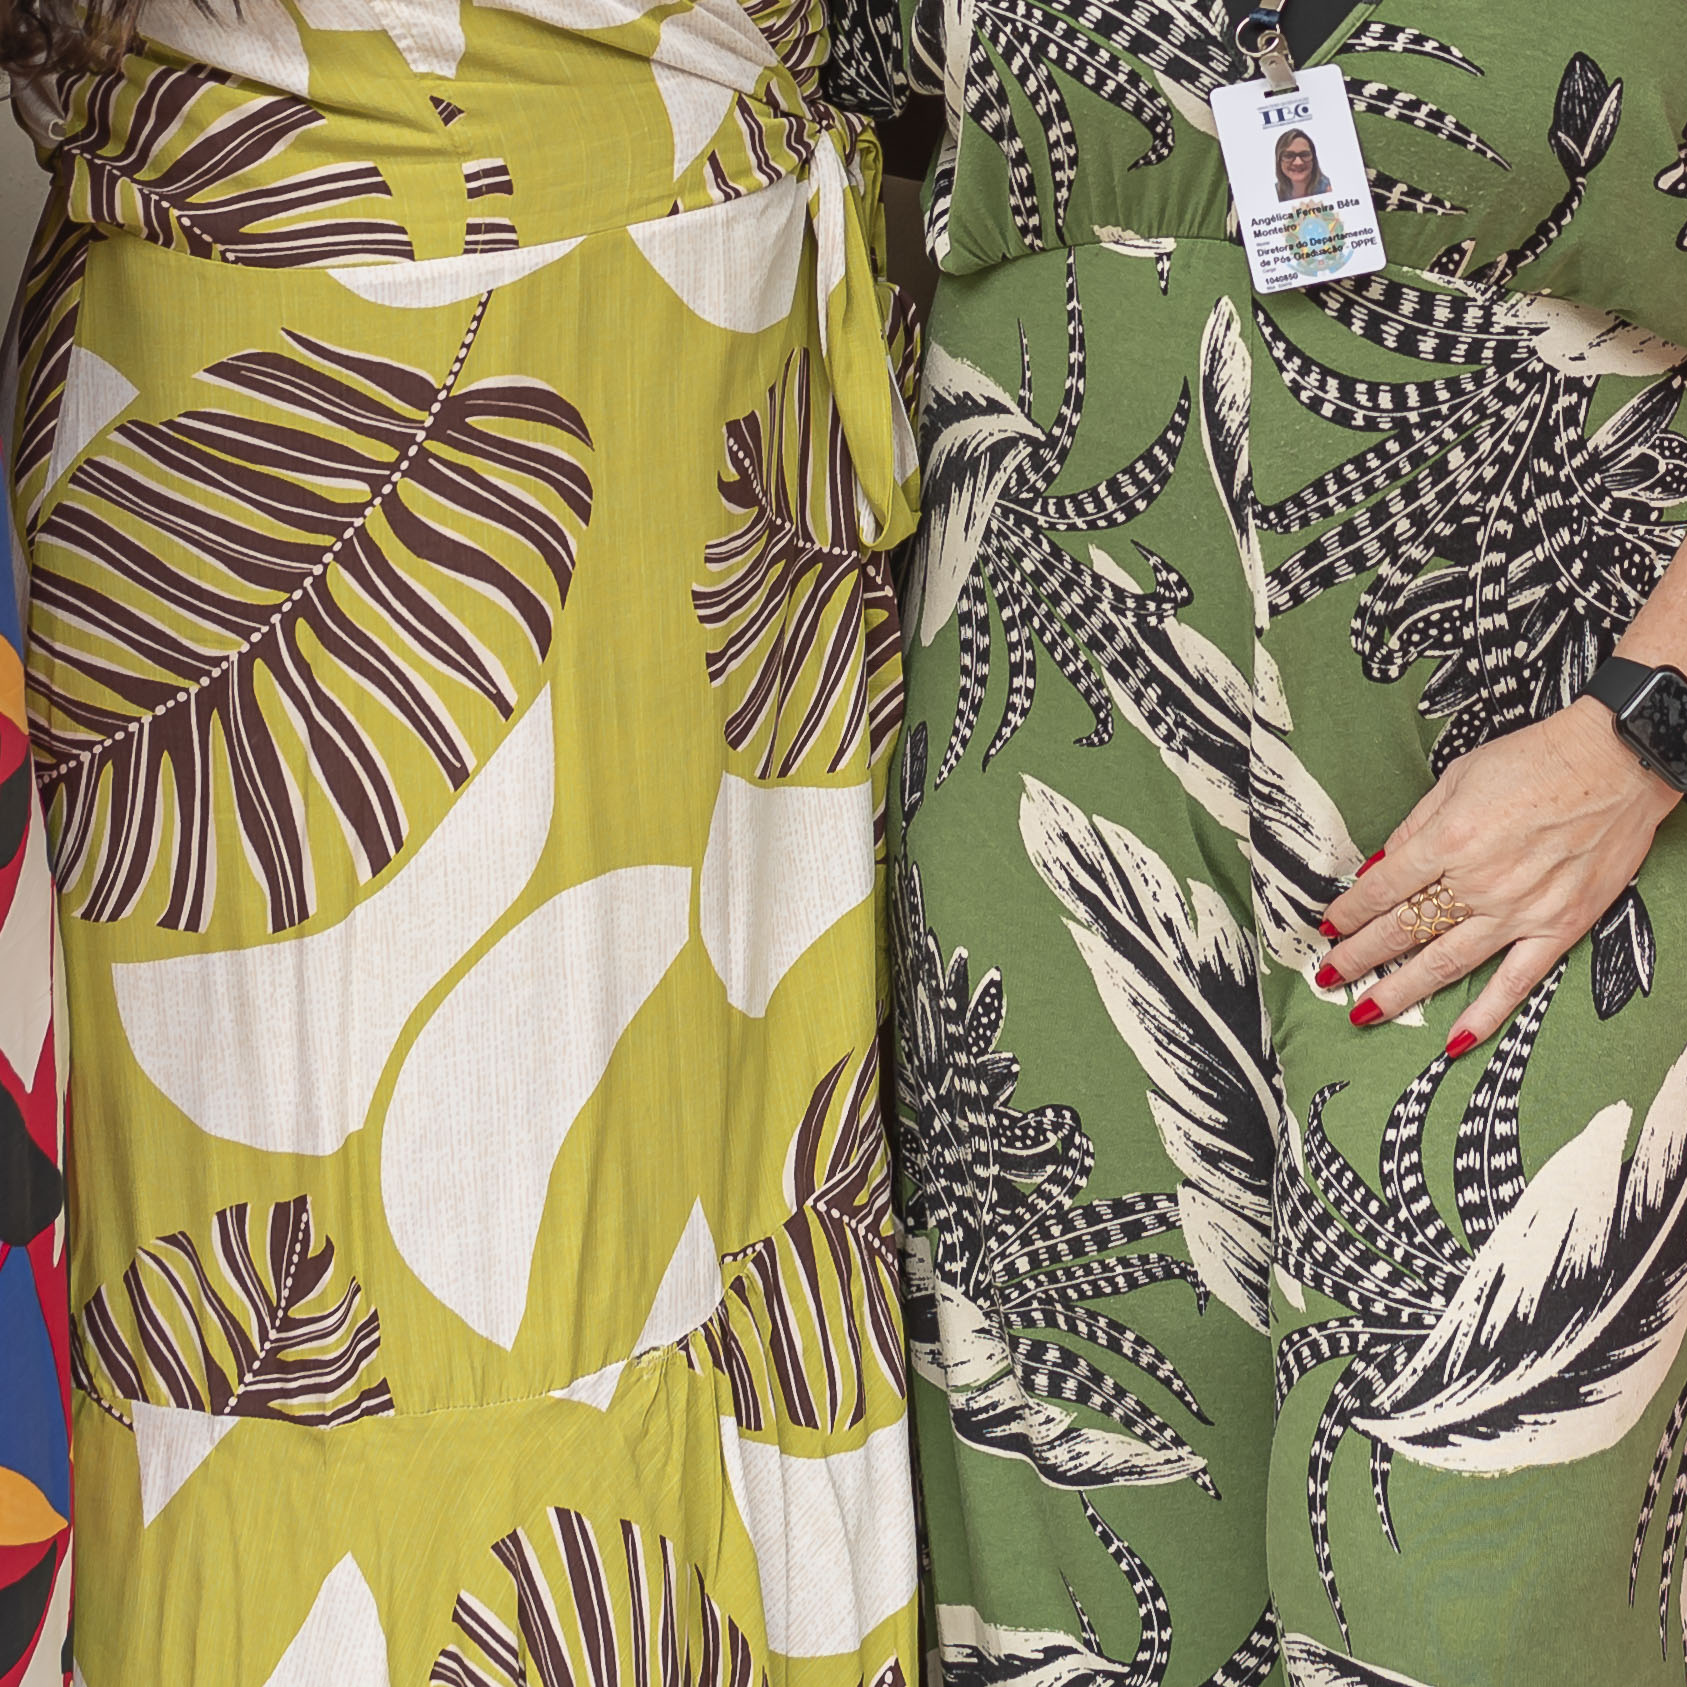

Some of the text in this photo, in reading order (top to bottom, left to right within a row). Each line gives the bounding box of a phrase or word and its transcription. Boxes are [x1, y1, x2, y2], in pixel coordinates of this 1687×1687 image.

[1250, 211, 1294, 227] Angélica
[1296, 203, 1334, 218] Ferreira
[1253, 224, 1298, 239] Monteiro
[1256, 242, 1294, 257] Diretora
[1296, 238, 1308, 249] do
[1309, 227, 1374, 247] Departamento
[1259, 257, 1271, 268] de
[1350, 237, 1378, 250] DPPE
